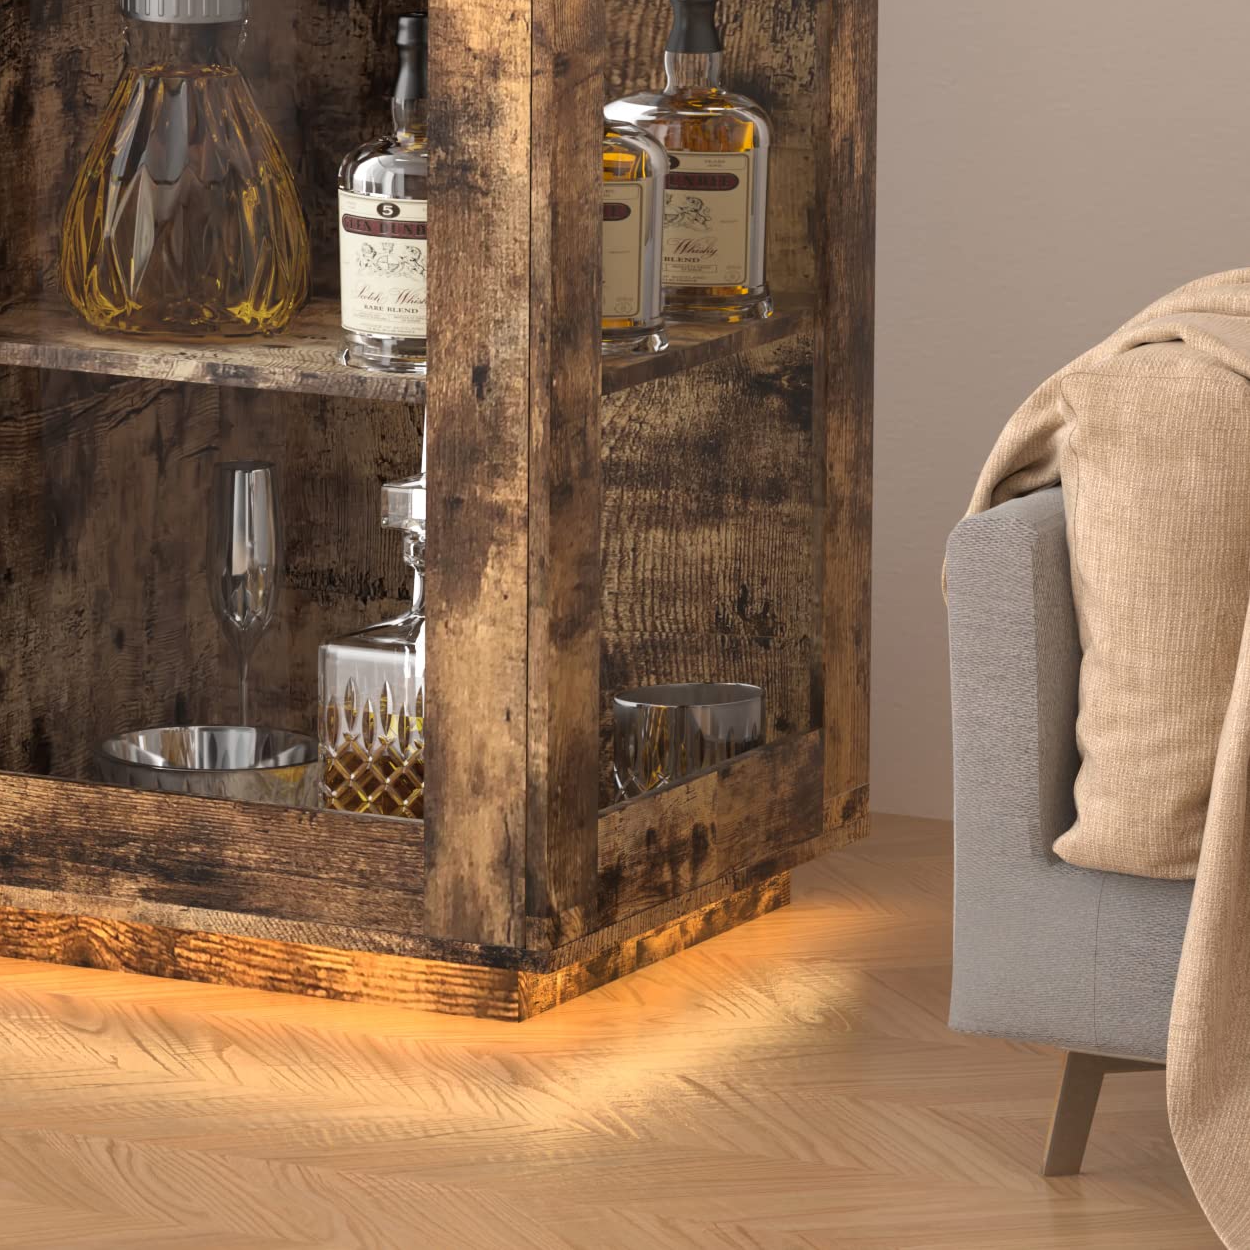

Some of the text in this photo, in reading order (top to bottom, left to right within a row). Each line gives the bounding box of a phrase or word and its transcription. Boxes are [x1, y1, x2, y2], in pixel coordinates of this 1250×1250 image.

[381, 205, 394, 216] 5
[667, 237, 718, 259] Whisky
[391, 288, 427, 304] Whis
